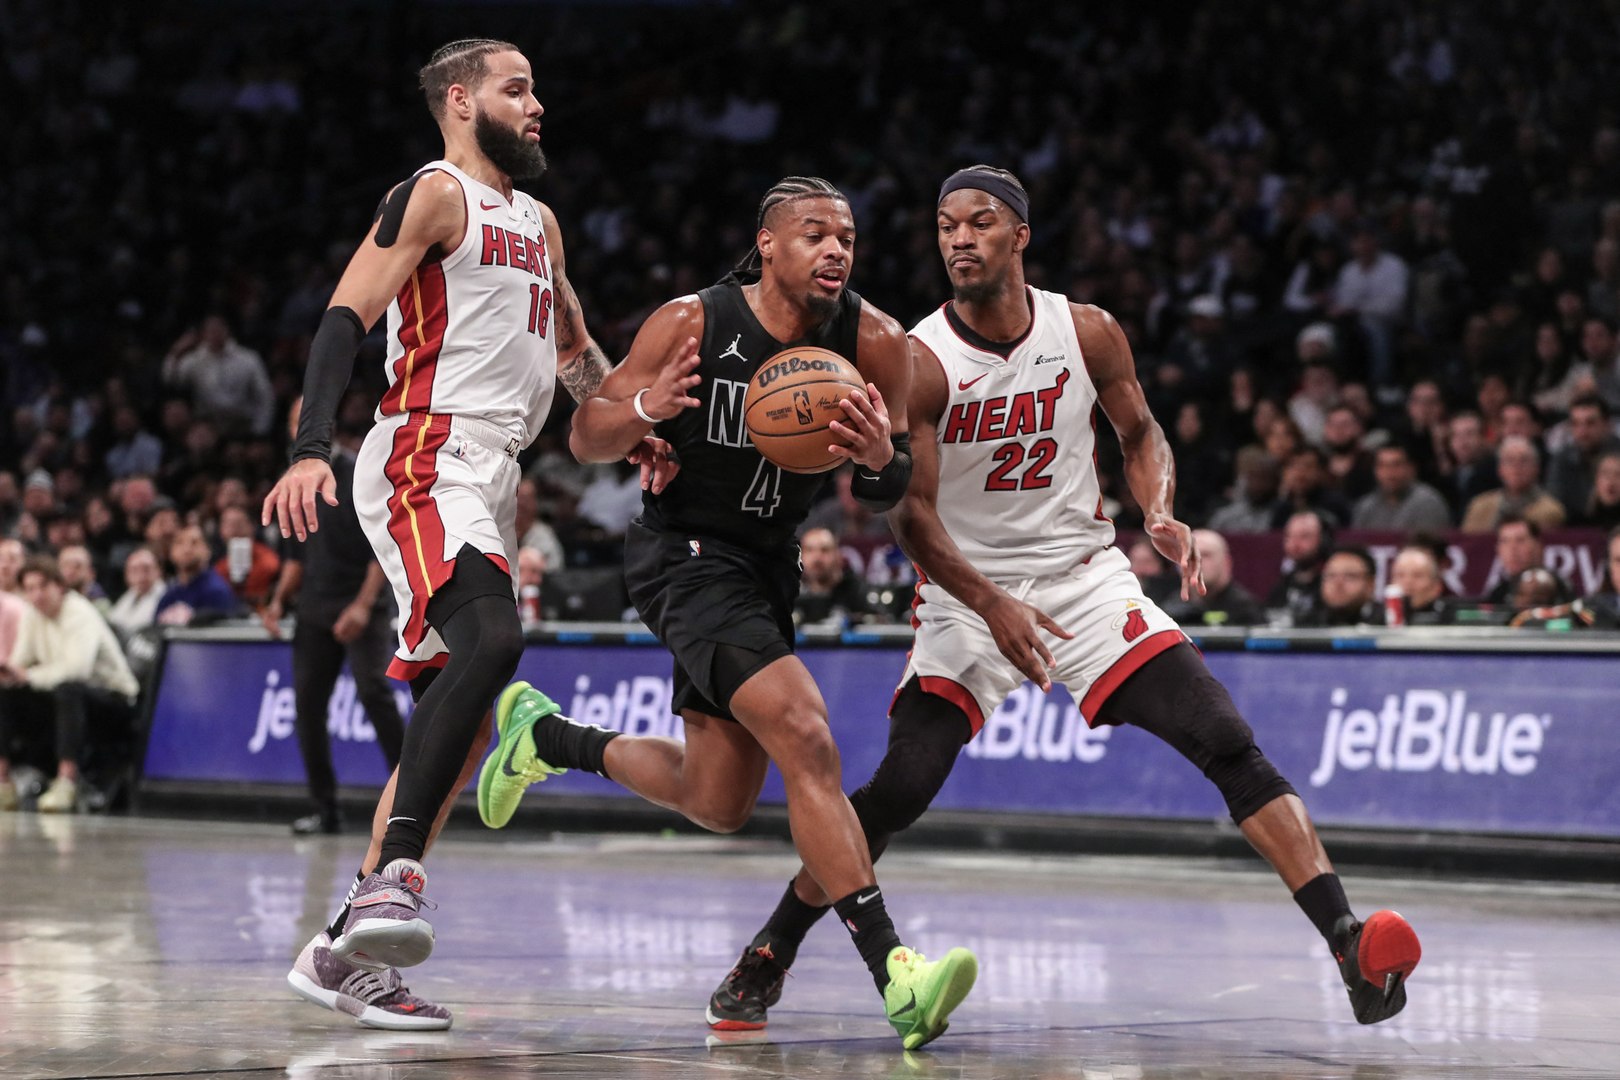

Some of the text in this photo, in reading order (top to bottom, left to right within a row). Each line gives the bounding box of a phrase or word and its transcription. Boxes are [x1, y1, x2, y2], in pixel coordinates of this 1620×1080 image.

[480, 223, 549, 281] HEAT
[528, 283, 553, 339] 16
[757, 357, 840, 388] Wilson
[942, 367, 1070, 443] HEAT
[741, 456, 782, 518] 4
[984, 437, 1058, 491] 22
[1309, 687, 1545, 788] jetBlue
